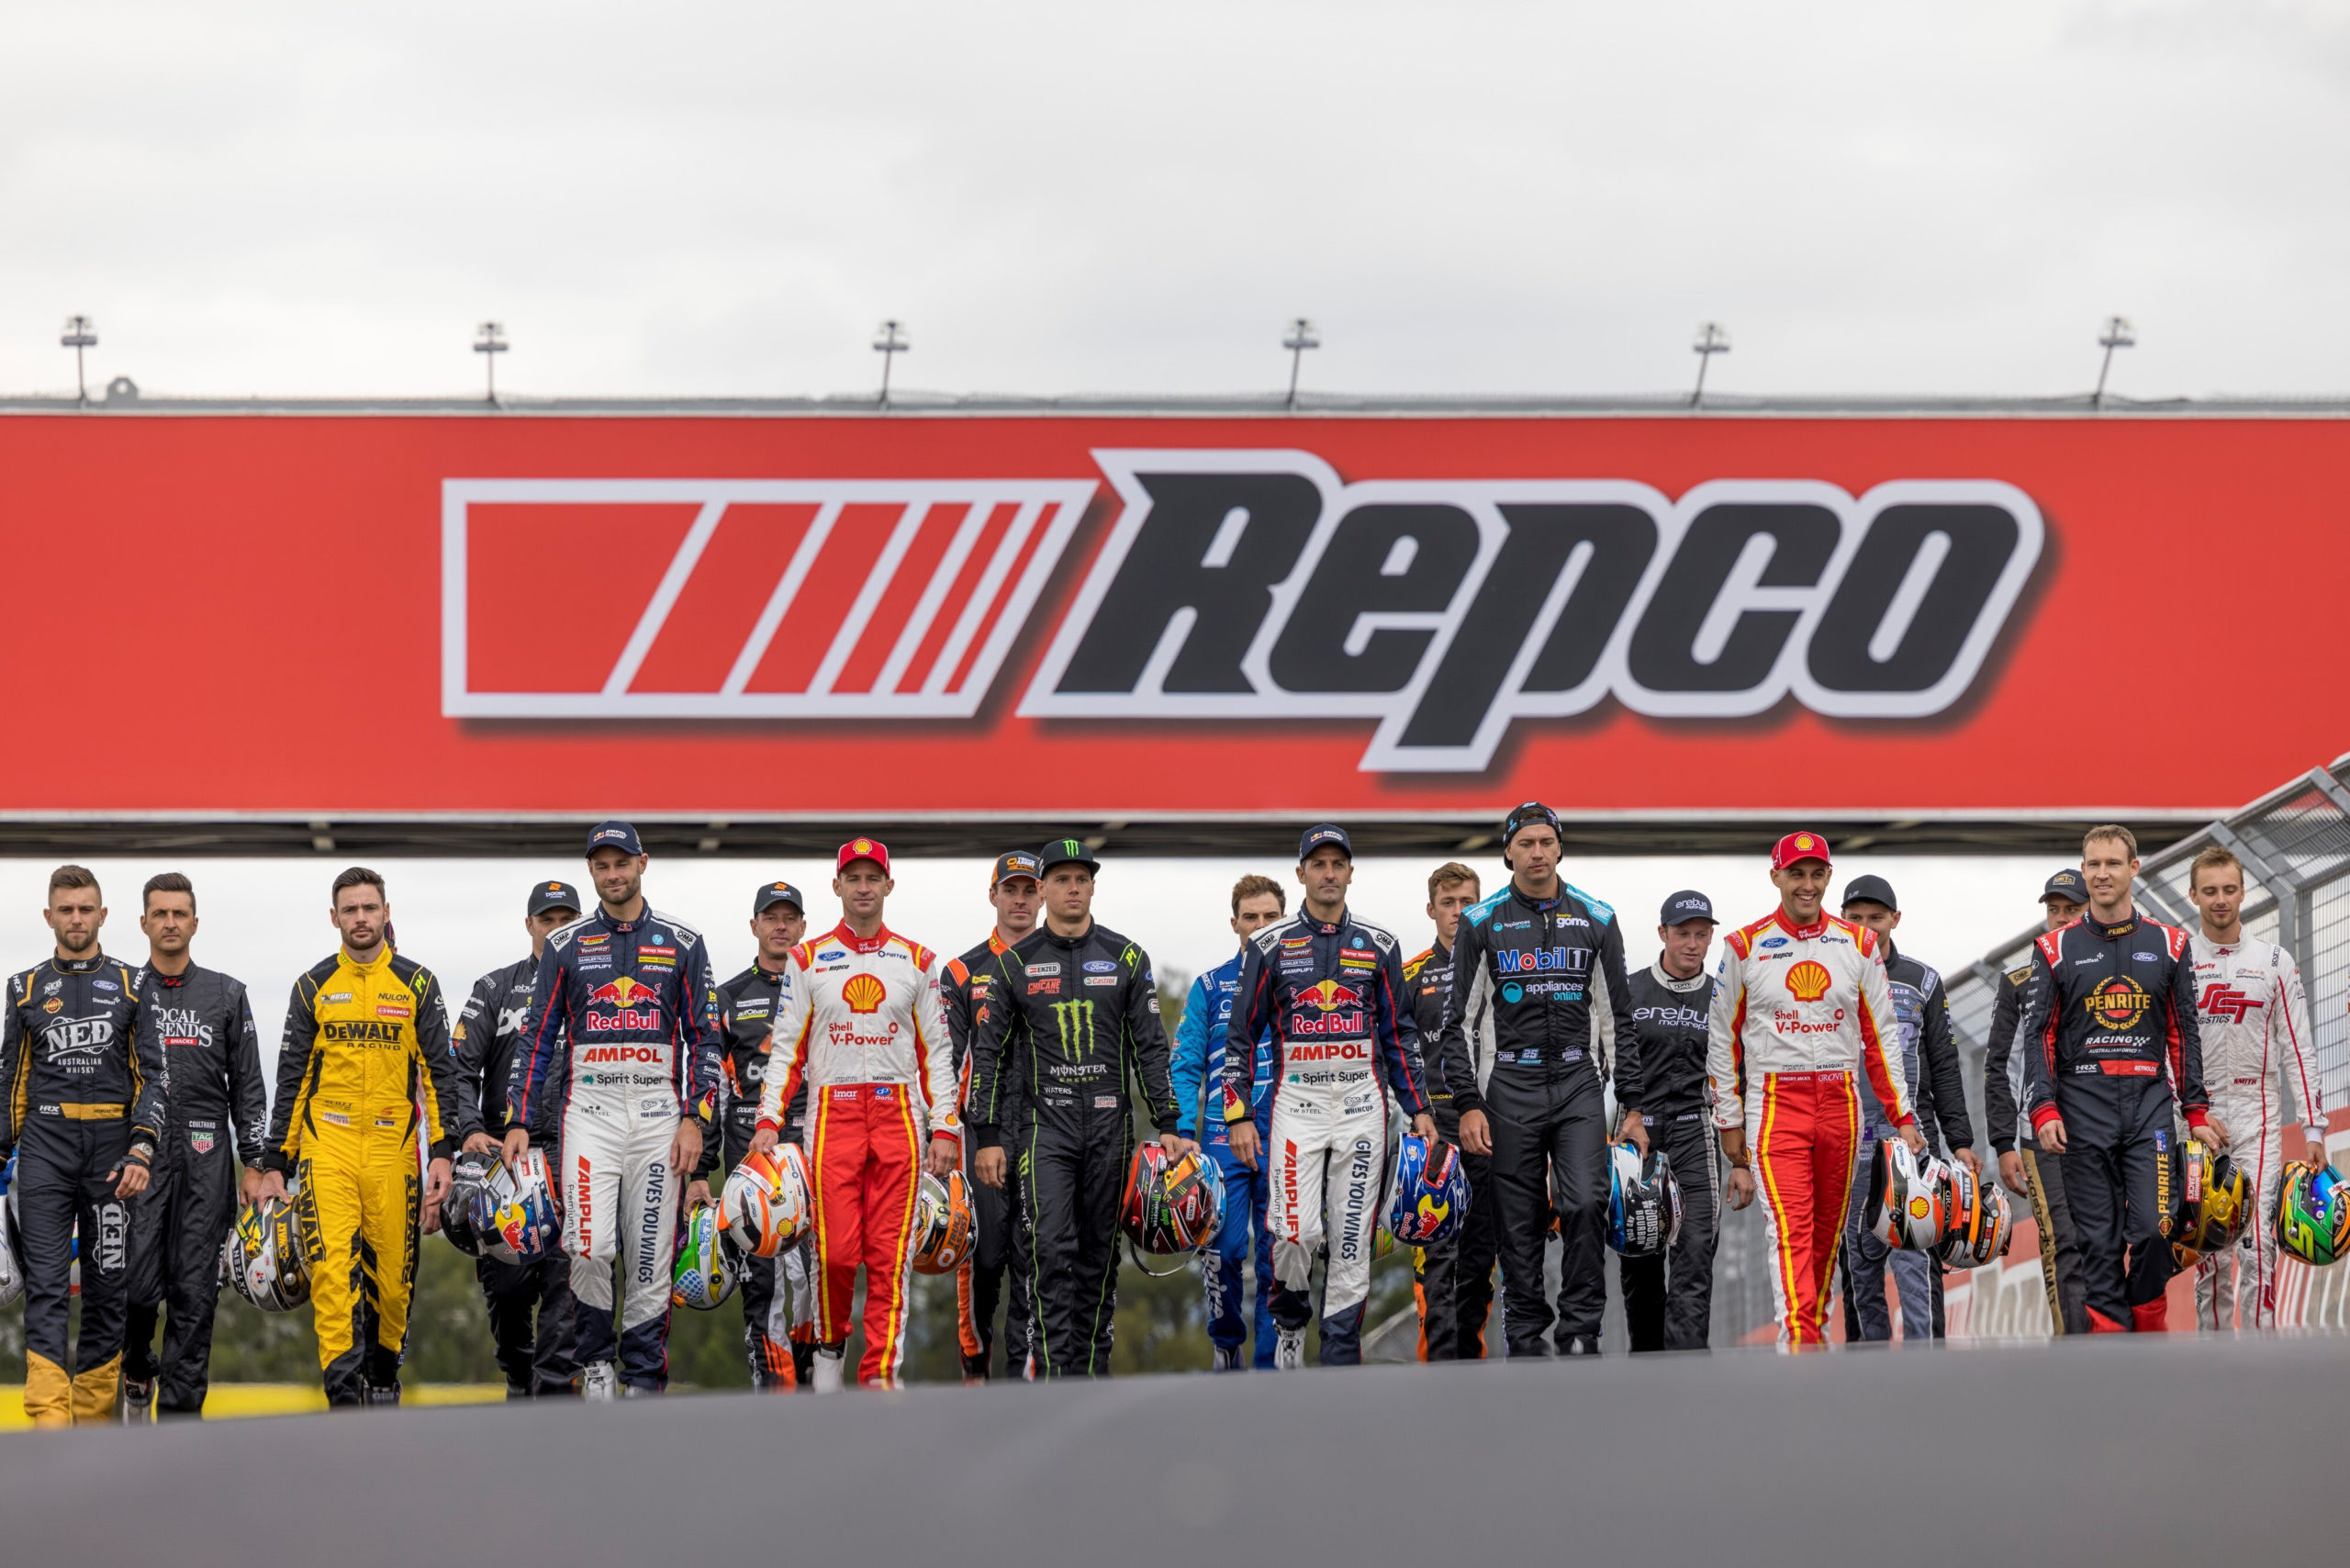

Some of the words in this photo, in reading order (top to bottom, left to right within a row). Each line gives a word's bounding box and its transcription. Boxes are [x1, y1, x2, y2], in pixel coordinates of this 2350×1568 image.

[1030, 457, 2034, 758] Repco
[1676, 898, 1707, 907] erebus
[1556, 917, 1589, 928] gomo
[2108, 924, 2133, 935] PENRITE
[554, 933, 570, 945] OMP
[677, 931, 693, 943] OMP
[1260, 936, 1275, 948] OMP
[1376, 934, 1392, 946] OMP
[2176, 932, 2185, 951] HRX
[2040, 936, 2054, 957] HRX
[1498, 948, 1565, 972] Mobil
[133, 969, 146, 991] HRX
[1027, 980, 1061, 992] CHICANE
[1526, 980, 1583, 995] appliances
[330, 992, 352, 1001] HUSKI
[377, 992, 409, 1002] NULON
[1553, 991, 1582, 1001] online
[2085, 993, 2151, 1012] PENRITE
[158, 1009, 200, 1024] OCAL
[738, 1009, 768, 1018] autobarn
[1634, 1004, 1709, 1025] erebu
[1774, 1010, 1798, 1020] Shell
[829, 1022, 852, 1032] Shell
[1659, 1018, 1709, 1031] motorspo
[1776, 1021, 1840, 1034] V-Power
[46, 1021, 113, 1053] NED
[830, 1034, 894, 1046] V-Power
[2086, 1036, 2132, 1046] RACING
[347, 1042, 401, 1050] RACING
[1289, 1045, 1367, 1060] AMPOL
[583, 1047, 663, 1063] AMPOL
[1050, 1064, 1107, 1075] MONSTER
[598, 1073, 629, 1085] Spirit
[633, 1074, 663, 1085] Super
[1303, 1072, 1335, 1085] Spirit
[1338, 1071, 1369, 1081] Super
[1818, 1073, 1844, 1082] GROVE
[834, 1090, 857, 1098] imar
[1345, 1105, 1373, 1114] WHINCUP
[189, 1121, 216, 1129] COULTHARD
[195, 1133, 212, 1141] TAG
[1355, 1139, 1371, 1181] GIVES
[647, 1163, 665, 1204] GIVES
[2158, 1153, 2169, 1214] PENRITE
[1285, 1154, 1299, 1246] AMPLIFY
[1349, 1181, 1367, 1211] YOU
[578, 1170, 591, 1261] AMPLIFY
[643, 1204, 662, 1236] YOU
[947, 1211, 961, 1247] TRUCK
[1636, 1209, 1646, 1245] BOURBON
[1642, 1199, 1659, 1250] WOODSTOCK
[101, 1202, 124, 1271] NED
[1342, 1211, 1361, 1260] WINGS
[638, 1236, 657, 1283] WINGS
